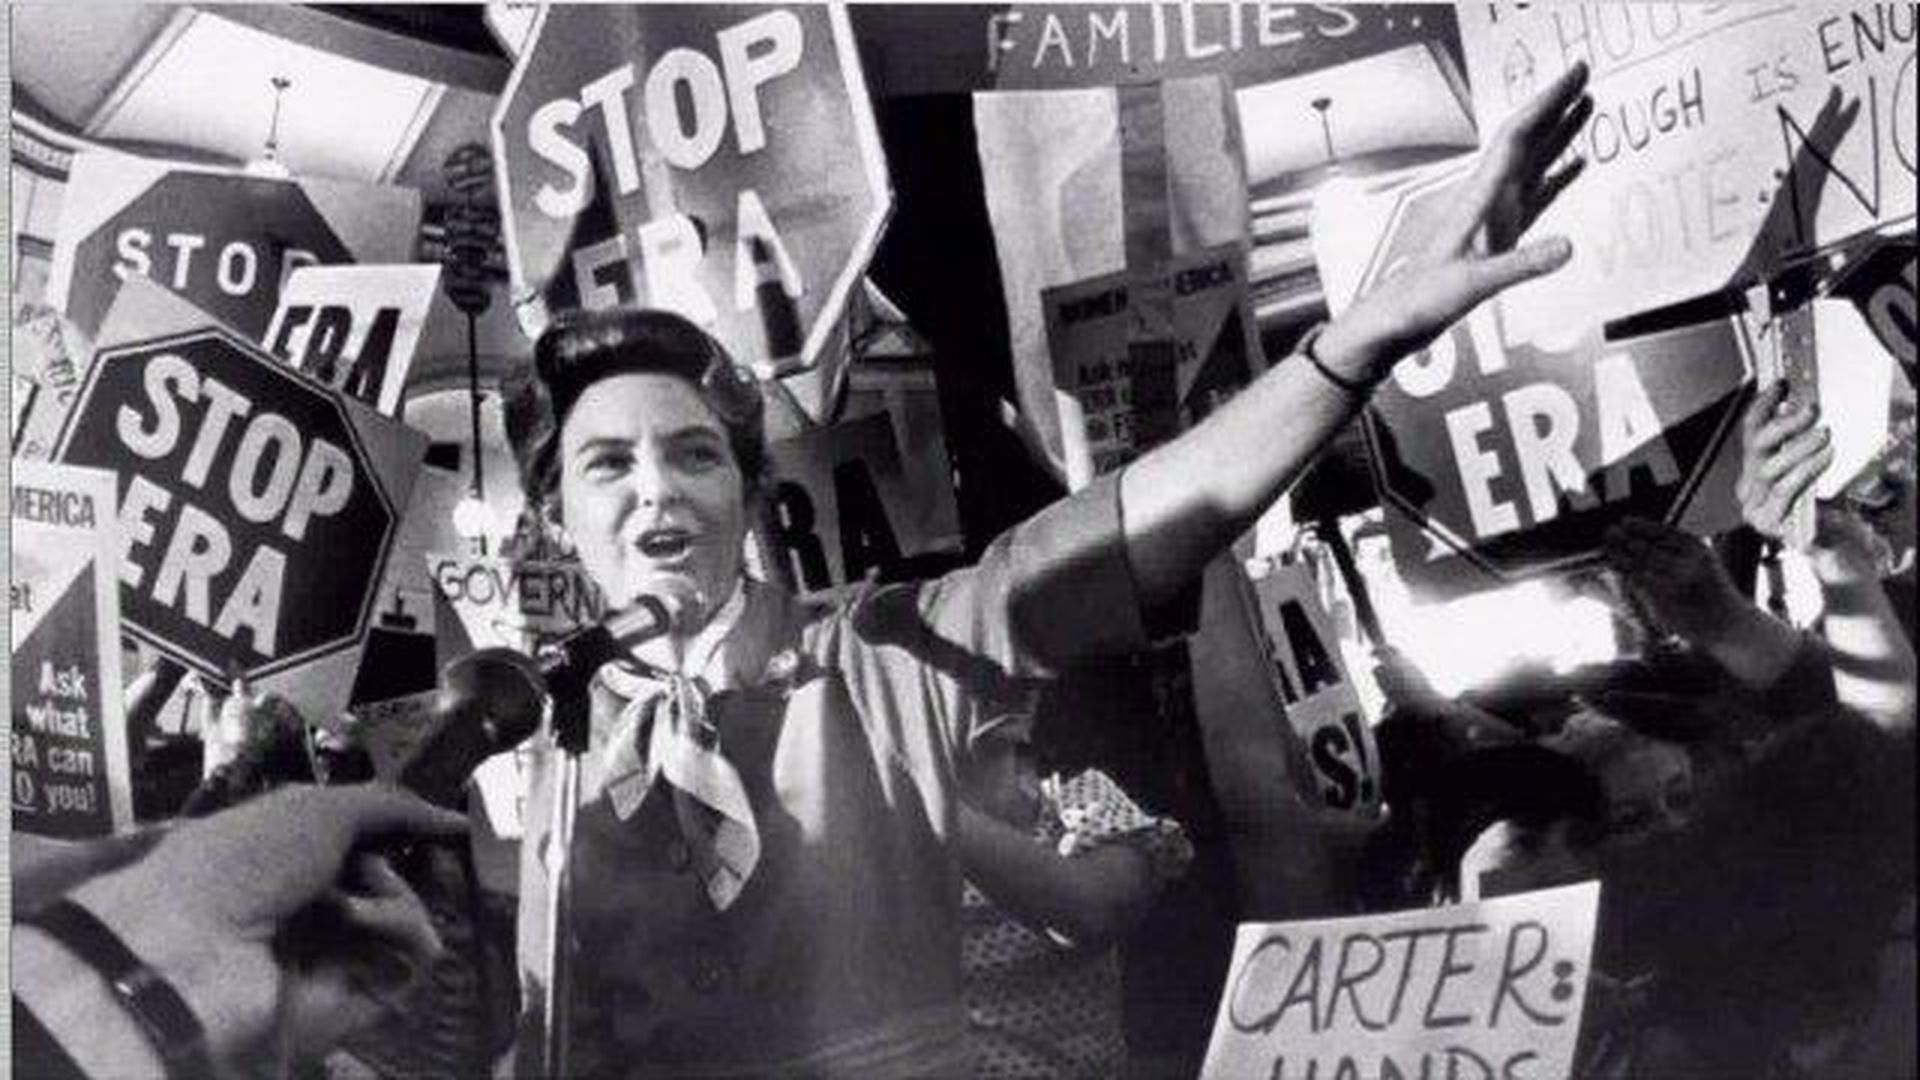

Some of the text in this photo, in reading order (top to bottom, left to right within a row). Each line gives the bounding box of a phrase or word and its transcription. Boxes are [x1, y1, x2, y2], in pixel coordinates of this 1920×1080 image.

[529, 9, 803, 218] STOP
[1589, 66, 1706, 164] OUGH
[1746, 55, 1800, 104] IS
[573, 189, 803, 327] ERA
[271, 305, 402, 409] ERA
[116, 354, 355, 542] STOP
[1445, 352, 1682, 538] ERA
[118, 474, 287, 658] ERA
[767, 455, 904, 593] RA
[25, 701, 91, 740] what
[39, 661, 88, 699] Ask
[46, 747, 95, 777] can
[1228, 920, 1577, 1036] CARTER:
